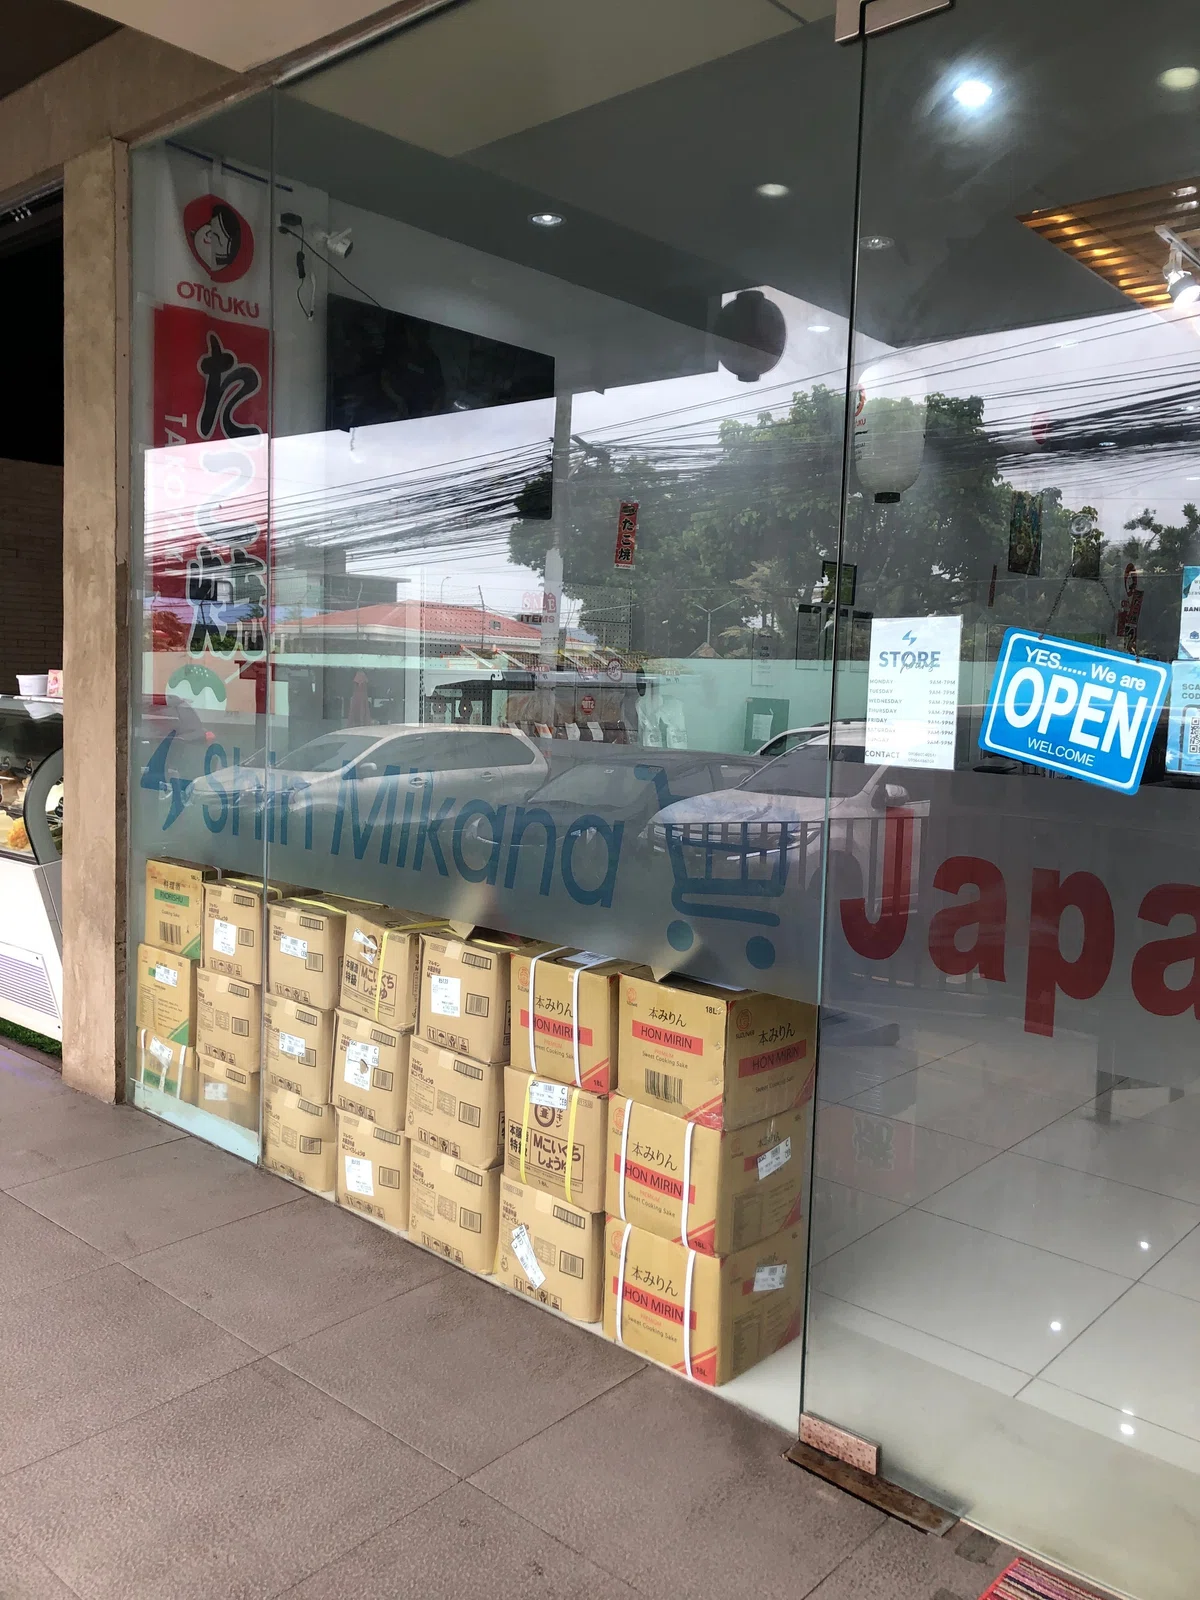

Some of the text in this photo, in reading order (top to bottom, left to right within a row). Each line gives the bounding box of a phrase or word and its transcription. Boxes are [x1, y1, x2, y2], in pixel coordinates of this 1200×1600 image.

[618, 518, 635, 561] たこ焼
[520, 614, 555, 623] ITEMS
[879, 650, 941, 668] STORE
[1090, 663, 1117, 684] We
[1119, 673, 1147, 692] are
[1003, 667, 1148, 760] OPEN
[865, 750, 900, 759] CONTACT
[1027, 736, 1096, 767] WELCOME
[202, 742, 625, 908] Shin Mikana
[536, 994, 574, 1018] 本みりん
[648, 1006, 687, 1028] 本みりん
[705, 1006, 717, 1015] 18L
[640, 1025, 693, 1049] HON MIRIN
[758, 1022, 796, 1046] 本みりん
[546, 1047, 565, 1059] Cooking
[642, 1050, 688, 1069] Sweet Cooking Sake
[752, 1046, 799, 1071] HON MIRIN
[593, 1079, 604, 1088] 18L
[632, 1141, 678, 1172] 本みりん
[625, 1162, 683, 1197] HON MIRIN
[627, 1191, 676, 1218] Sweet Cooking Sake
[631, 1265, 679, 1297] 本みりん
[624, 1285, 684, 1322] HON MIRIN
[627, 1314, 677, 1343] Sweet Cooking Sake
